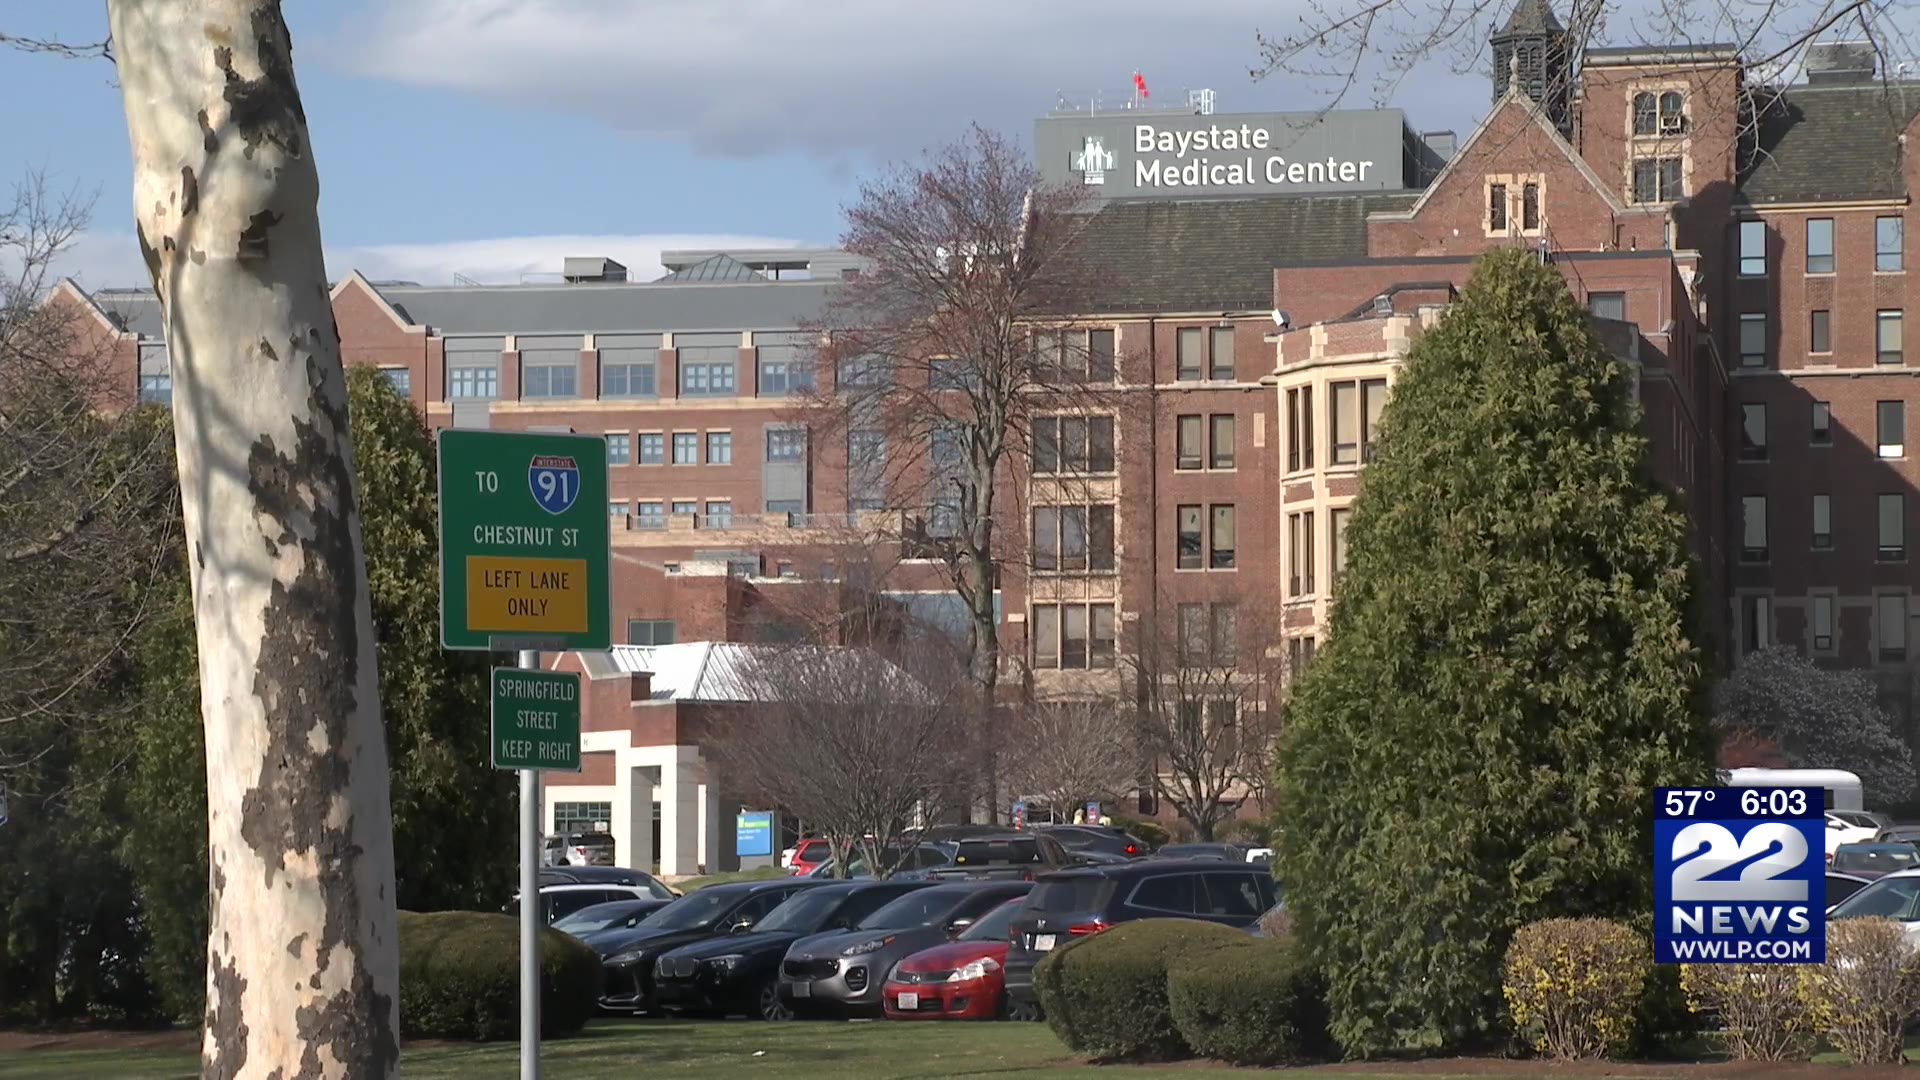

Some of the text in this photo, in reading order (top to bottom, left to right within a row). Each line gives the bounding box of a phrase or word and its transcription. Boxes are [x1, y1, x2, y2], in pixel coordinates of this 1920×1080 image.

[1135, 124, 1269, 158] Baystate
[1135, 156, 1374, 188] Medical Center
[475, 470, 569, 504] TO 91
[473, 524, 579, 546] CHESTNUT ST
[484, 569, 570, 590] LEFT LANE
[507, 598, 548, 617] ONLY
[499, 678, 575, 701] SPRINGFIELD
[516, 710, 558, 730] STREET
[502, 739, 572, 761] KEEP RIGHT
